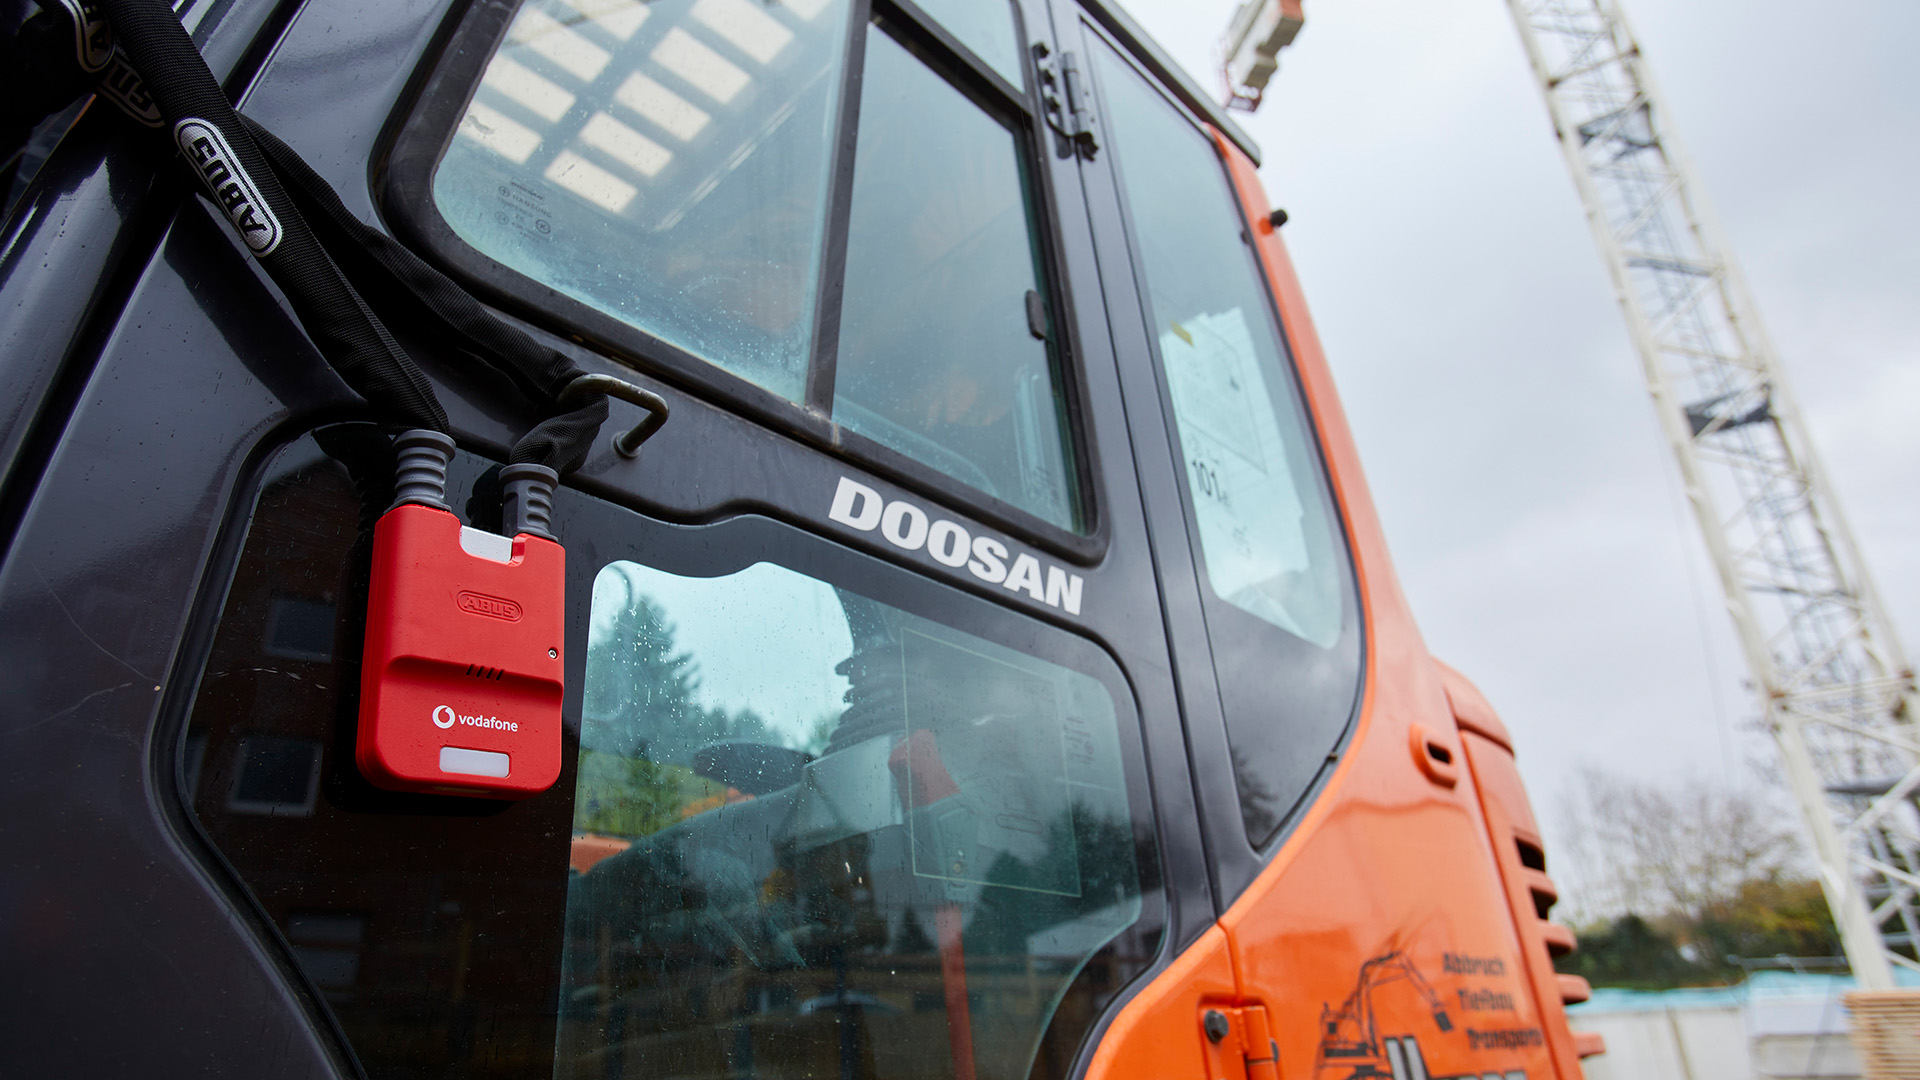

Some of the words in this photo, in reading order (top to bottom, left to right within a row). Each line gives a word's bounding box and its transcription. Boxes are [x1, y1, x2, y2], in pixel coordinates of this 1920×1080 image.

[186, 135, 268, 237] ABUS
[828, 476, 1083, 616] DOOSAN
[464, 596, 515, 619] ABUS
[458, 713, 518, 733] vodafone
